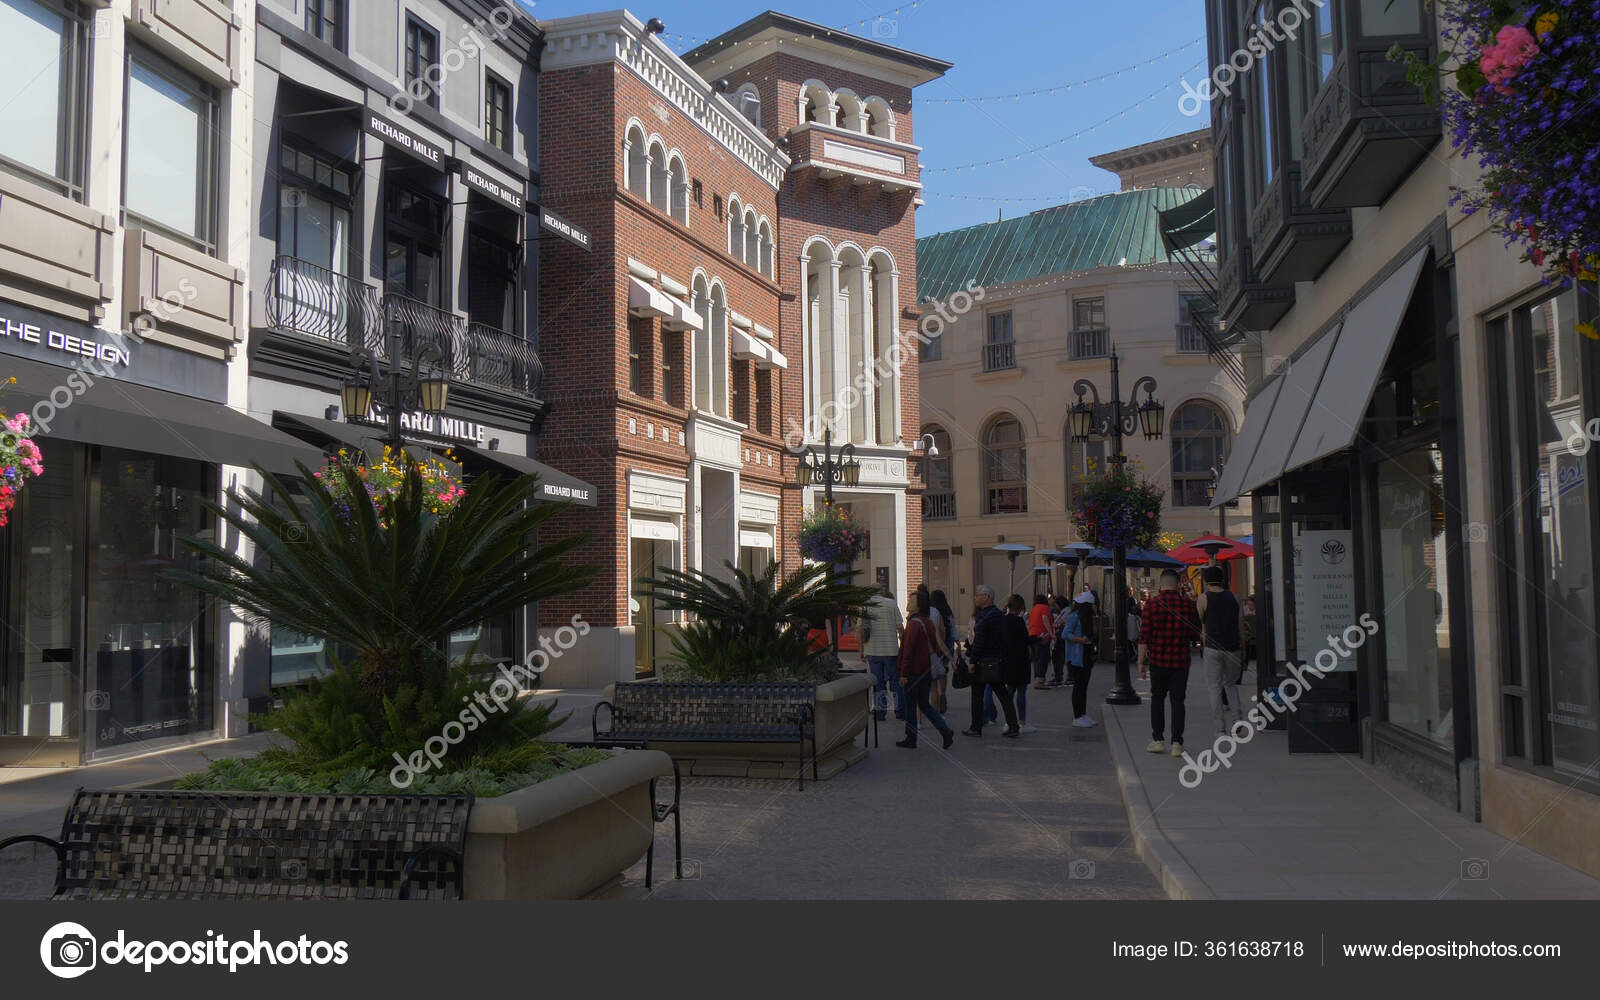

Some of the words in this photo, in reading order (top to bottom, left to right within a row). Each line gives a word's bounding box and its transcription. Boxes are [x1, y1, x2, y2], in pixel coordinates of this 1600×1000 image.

[371, 116, 411, 148] RICHARD
[413, 139, 439, 163] MILLE
[467, 170, 499, 196] RICHARD
[500, 190, 521, 208] MILLE
[544, 214, 570, 236] RICHARD
[570, 228, 588, 245] MILLE
[48, 330, 129, 366] DESIGN
[440, 416, 486, 442] MILLE
[544, 484, 570, 497] RICHARD
[571, 489, 589, 500] MILLE
